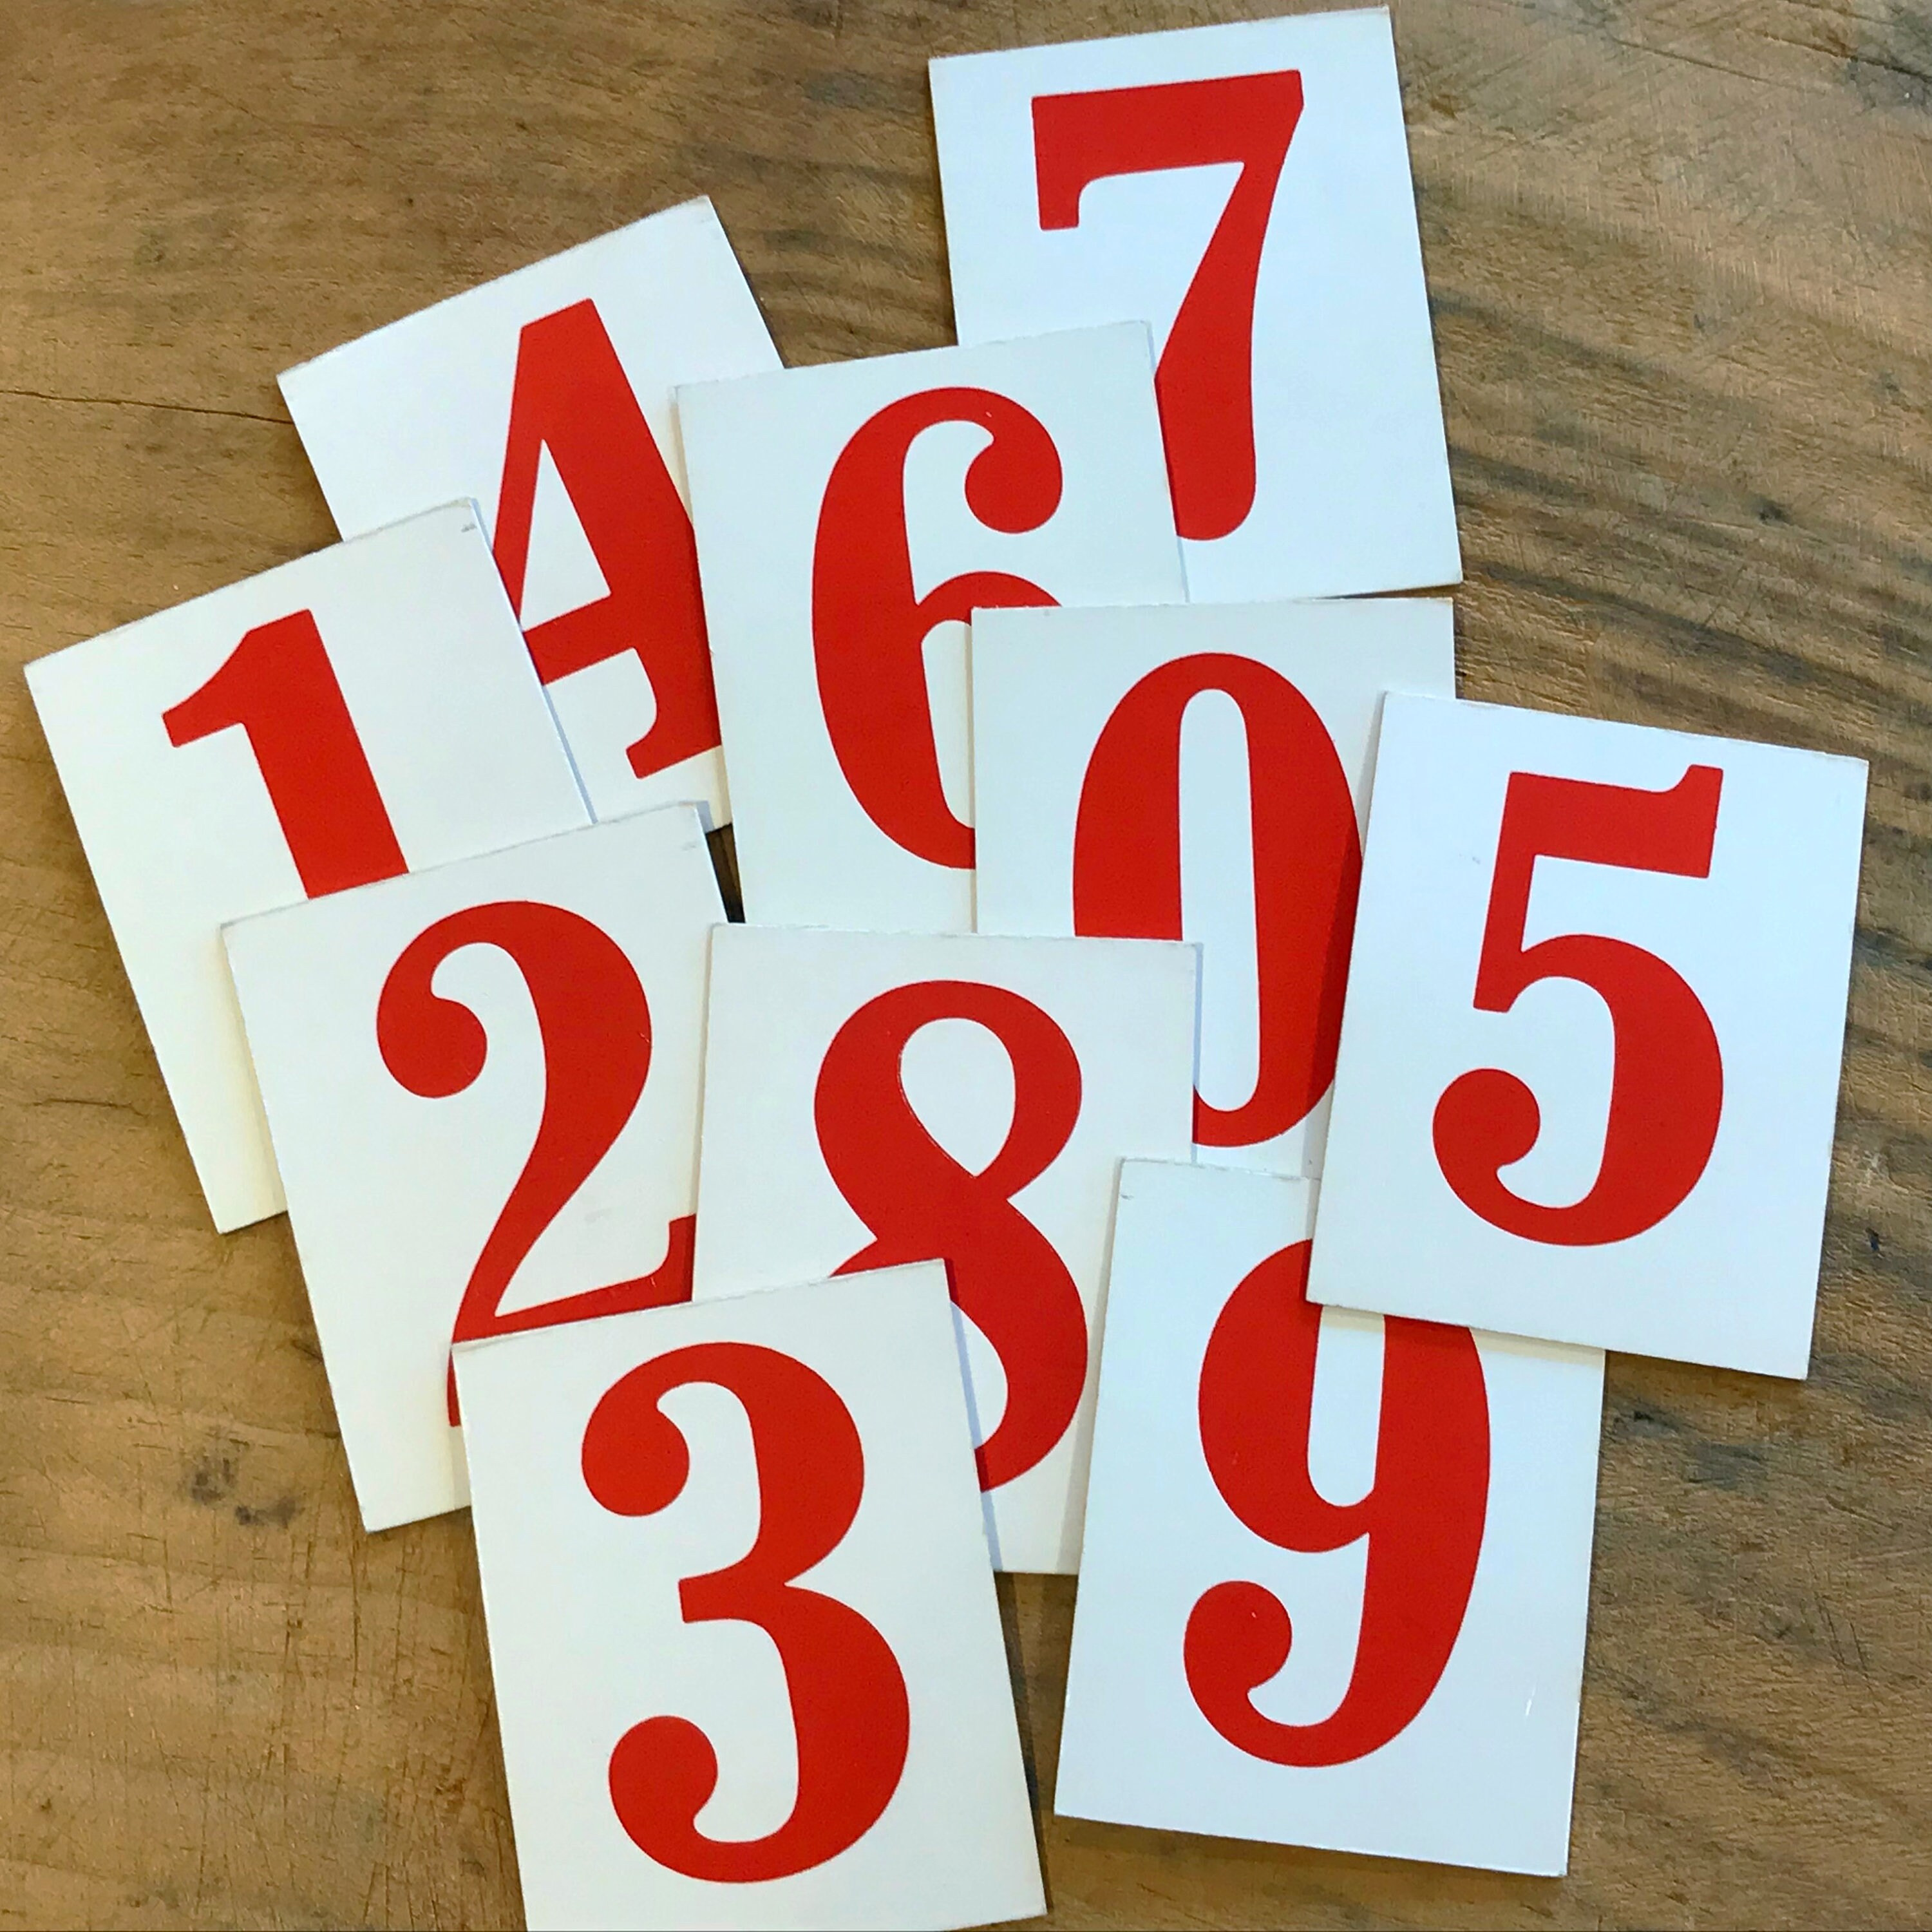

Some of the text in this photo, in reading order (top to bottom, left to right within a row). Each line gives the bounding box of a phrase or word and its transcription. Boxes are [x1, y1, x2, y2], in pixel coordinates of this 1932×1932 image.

[493, 299, 720, 778] 4
[1032, 71, 1303, 539] 7
[164, 610, 408, 898] 1
[813, 388, 1062, 869] 6
[1074, 653, 1361, 1146] 0
[1434, 765, 1723, 1246] 5
[377, 901, 696, 1426] 2
[815, 981, 1088, 1492] 8
[582, 1342, 909, 1883] 3
[1184, 1240, 1490, 1767] 9
